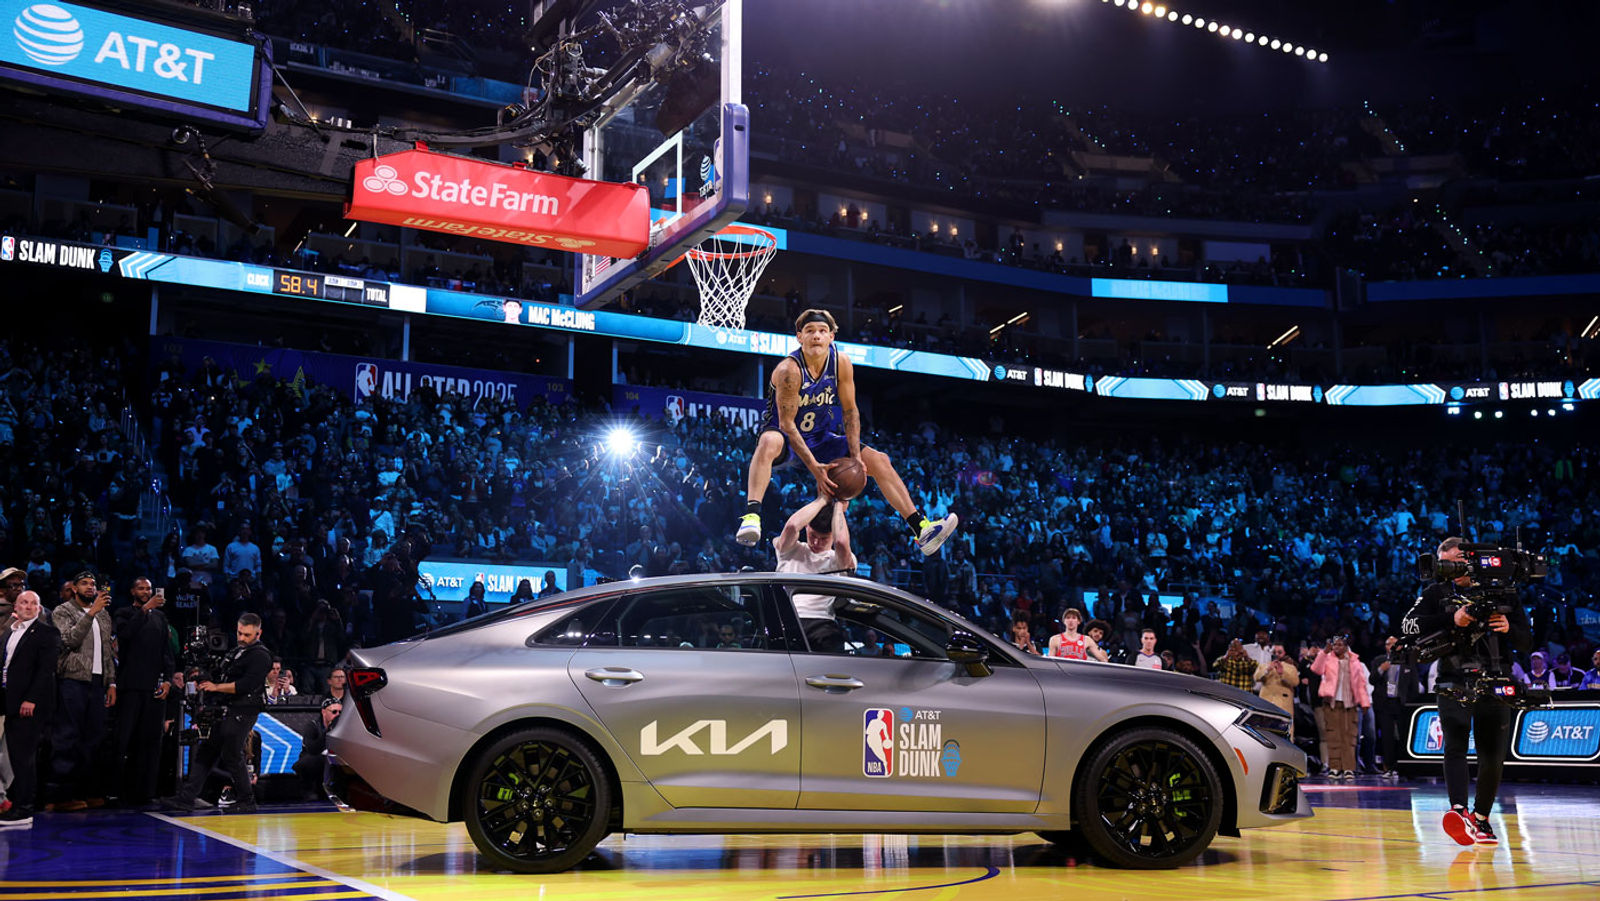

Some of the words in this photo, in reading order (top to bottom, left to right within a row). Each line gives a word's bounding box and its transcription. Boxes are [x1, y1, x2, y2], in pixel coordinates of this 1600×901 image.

[94, 31, 215, 85] AT&T
[19, 240, 56, 265] SLAM
[59, 245, 96, 270] DUNK
[280, 274, 318, 296] 58.4
[366, 287, 388, 302] TOTAL
[528, 306, 550, 325] MAC
[551, 308, 595, 331] McCLUNG
[759, 332, 787, 358] SLAM
[1007, 369, 1027, 381] AT&T
[1044, 370, 1063, 388] SLAM
[1226, 387, 1249, 397] AT&T
[1266, 384, 1289, 400] SLAM
[1465, 387, 1490, 398] AT&T
[1510, 382, 1536, 399] SLAM
[800, 411, 816, 432] 8
[437, 577, 464, 588] AT&T
[488, 574, 514, 593] SLAM
[516, 576, 542, 593] DNK
[915, 710, 941, 720] AT&T
[640, 719, 788, 755] KIA
[899, 723, 942, 750] SLAM
[1551, 725, 1594, 739] AT&T
[867, 761, 882, 773] NBA
[899, 750, 941, 777] DUNK
